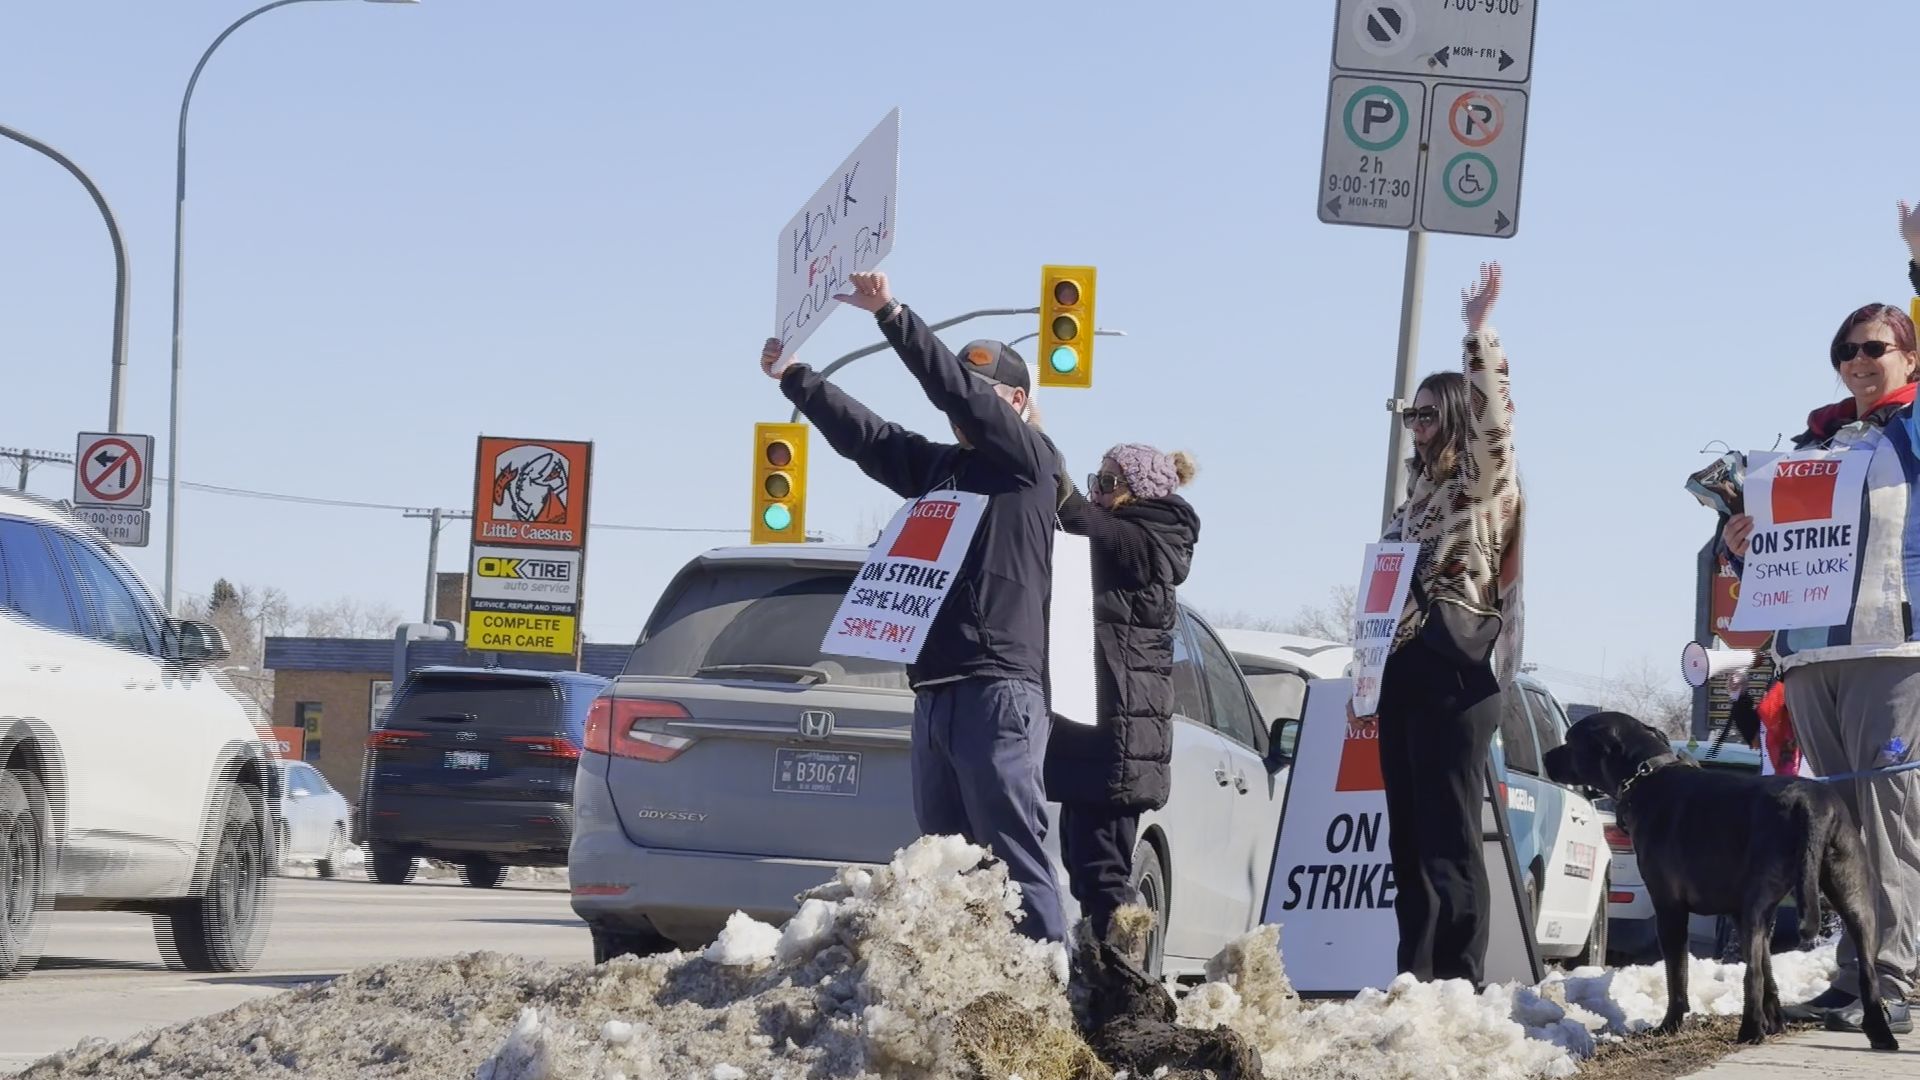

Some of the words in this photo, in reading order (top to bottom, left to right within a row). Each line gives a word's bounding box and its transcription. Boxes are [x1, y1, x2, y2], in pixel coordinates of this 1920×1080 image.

[1452, 46, 1496, 58] MON-FRI
[1359, 155, 1369, 173] 2
[1374, 156, 1383, 174] h
[1329, 174, 1410, 198] 9:00-17:30
[1348, 197, 1388, 209] MON-FRI
[794, 160, 860, 274] HONK
[781, 256, 847, 350] EQUAL
[1774, 462, 1841, 479] MGEU
[909, 502, 959, 520] MGEU
[482, 522, 518, 538] Little
[521, 524, 573, 542] Caesars
[1752, 532, 1778, 555] ON
[1783, 524, 1851, 552] STRIKE
[477, 557, 524, 579] OK
[528, 562, 568, 578] TIRE
[861, 562, 888, 581] ON
[885, 563, 950, 591] STRIKE
[504, 580, 529, 591] auto
[531, 582, 570, 593] service
[1752, 590, 1794, 608] SAME
[1803, 585, 1830, 603] PAY
[507, 602, 534, 611] REPAIR
[535, 603, 550, 611] AND
[551, 604, 572, 613] TIRES
[483, 615, 560, 631] COMPLETE
[838, 617, 882, 641] SAME
[1365, 618, 1395, 638] STRIKE
[482, 632, 511, 646] CAR
[515, 634, 555, 648] CARE
[1348, 721, 1379, 739] MG
[797, 762, 856, 785] B30674
[638, 809, 708, 822] ODYSSEY
[1326, 812, 1382, 854] ON
[1282, 863, 1396, 911] STRIKE
